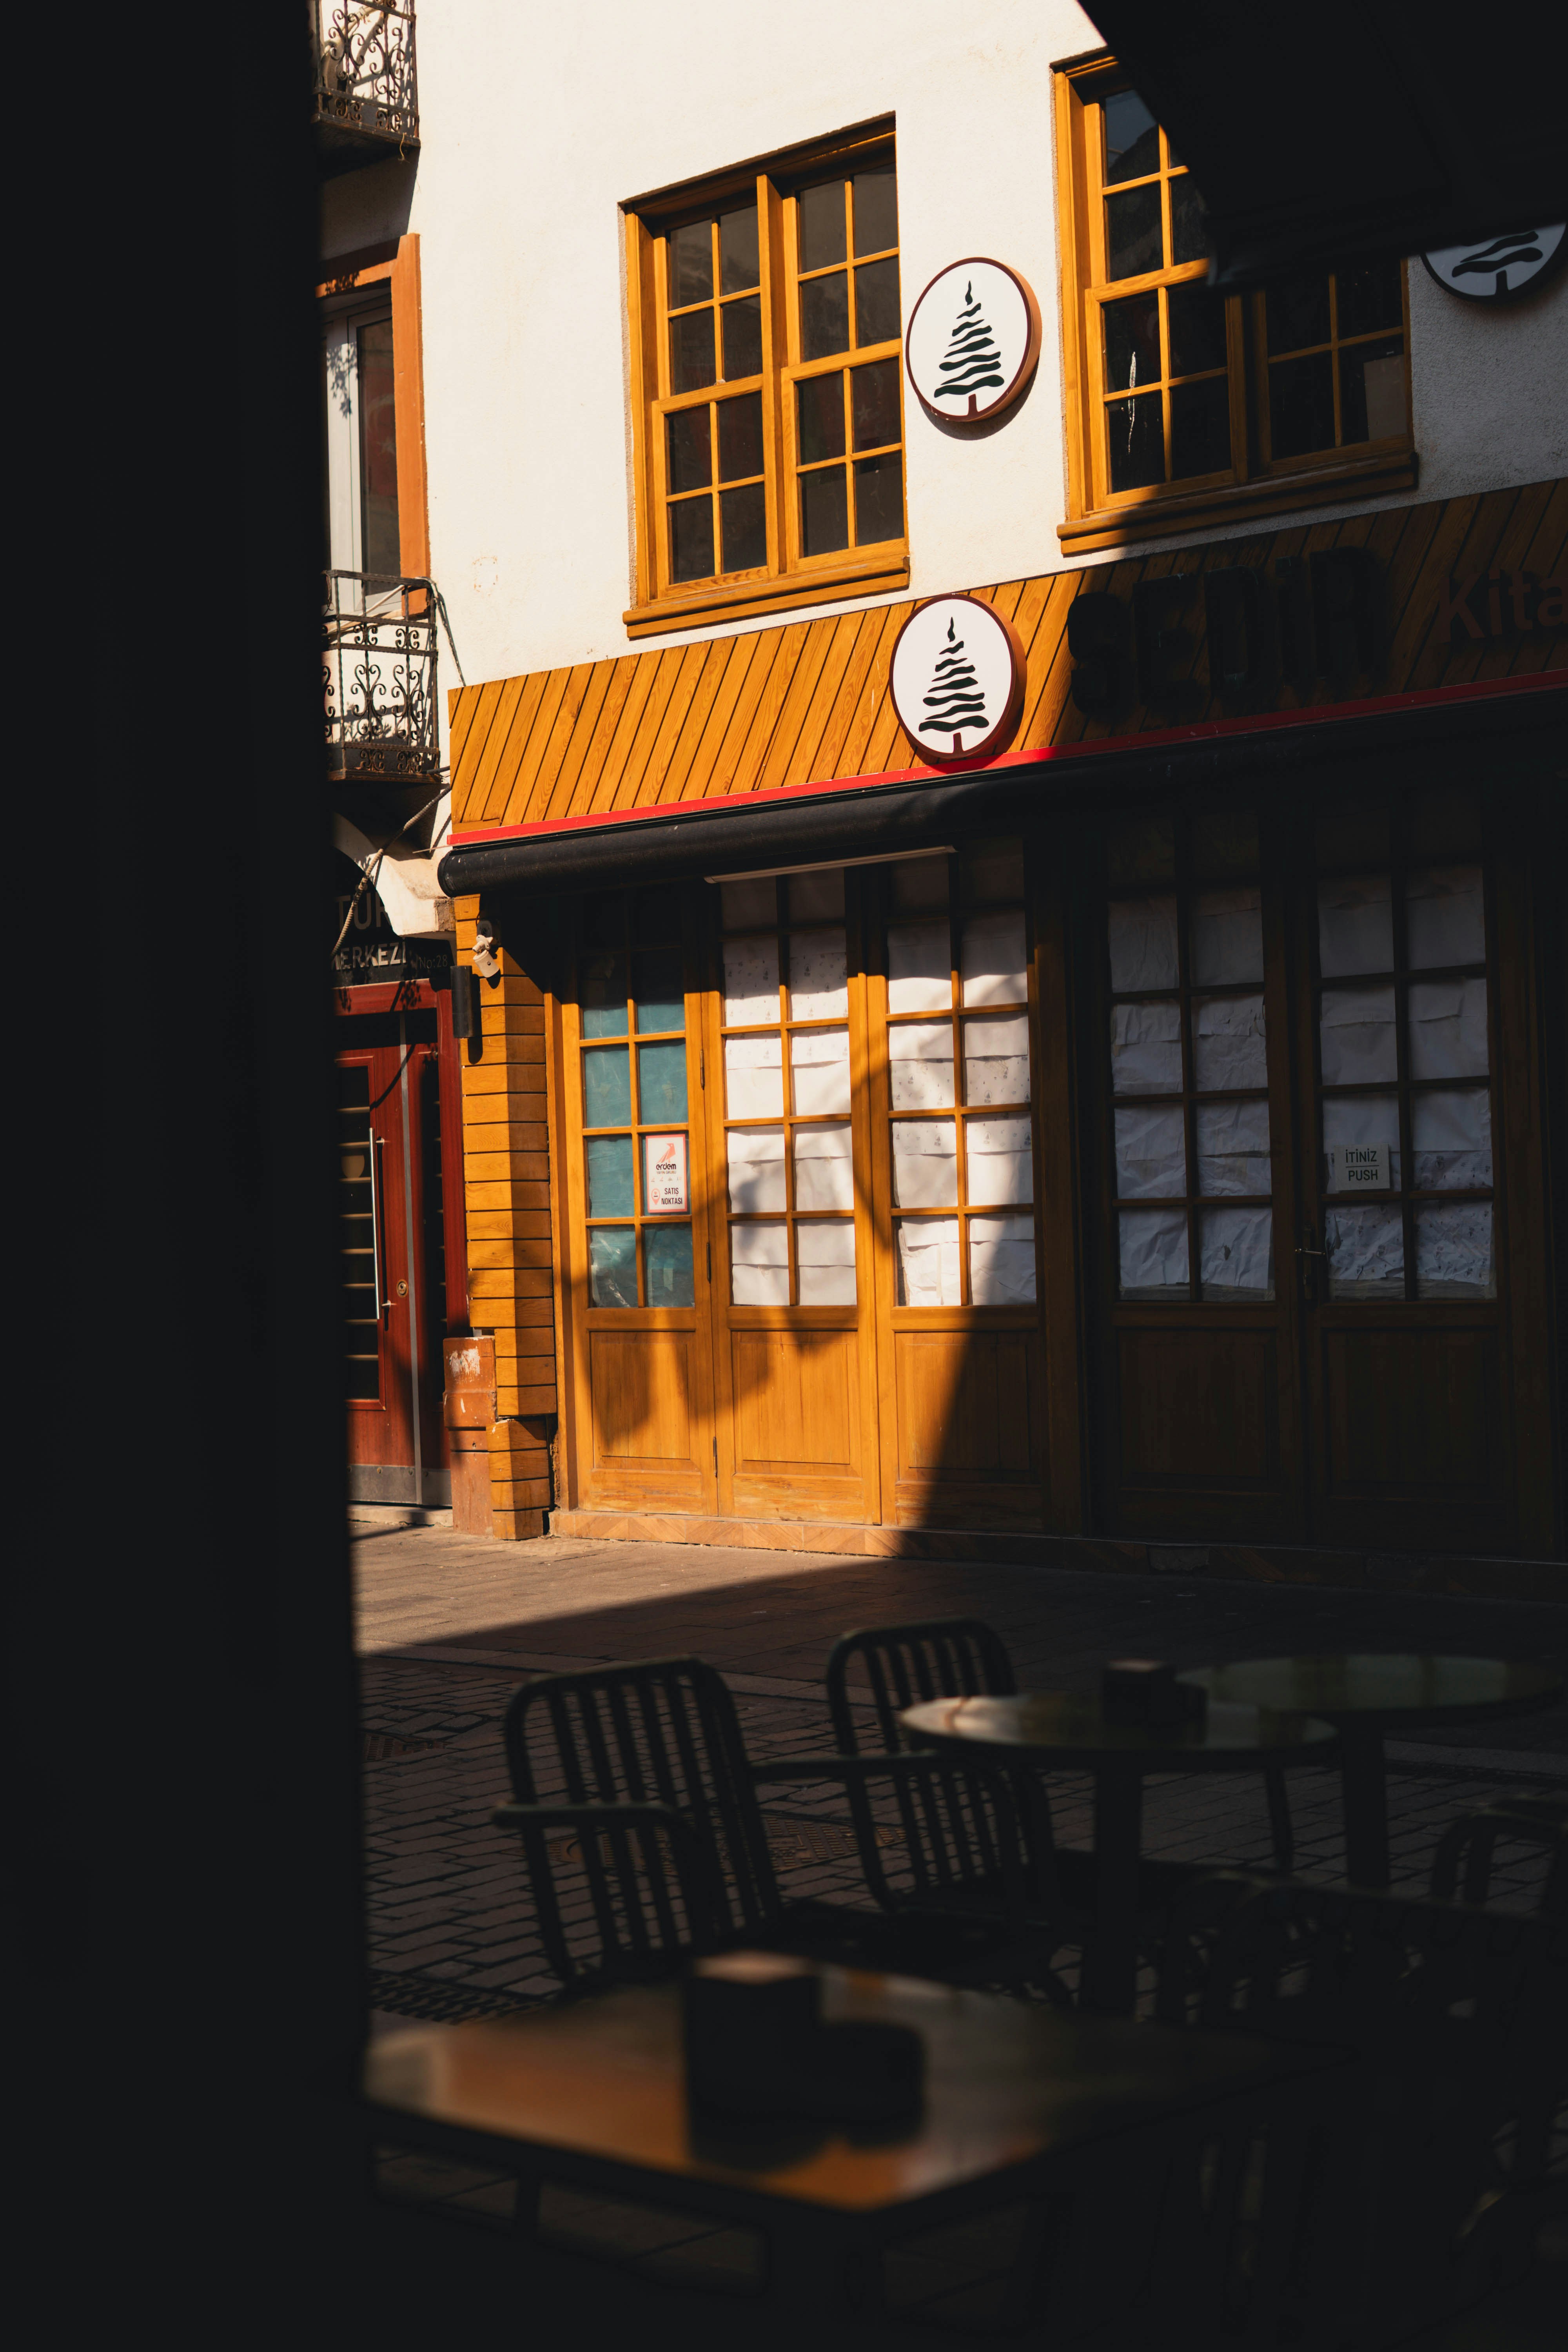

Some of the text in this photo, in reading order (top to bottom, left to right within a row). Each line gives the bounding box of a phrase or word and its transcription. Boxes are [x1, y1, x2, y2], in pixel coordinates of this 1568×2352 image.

[1345, 1148, 1377, 1163] İTİNİZ
[1348, 1170, 1378, 1181] PUSH
[664, 1188, 679, 1196] SATIŞ
